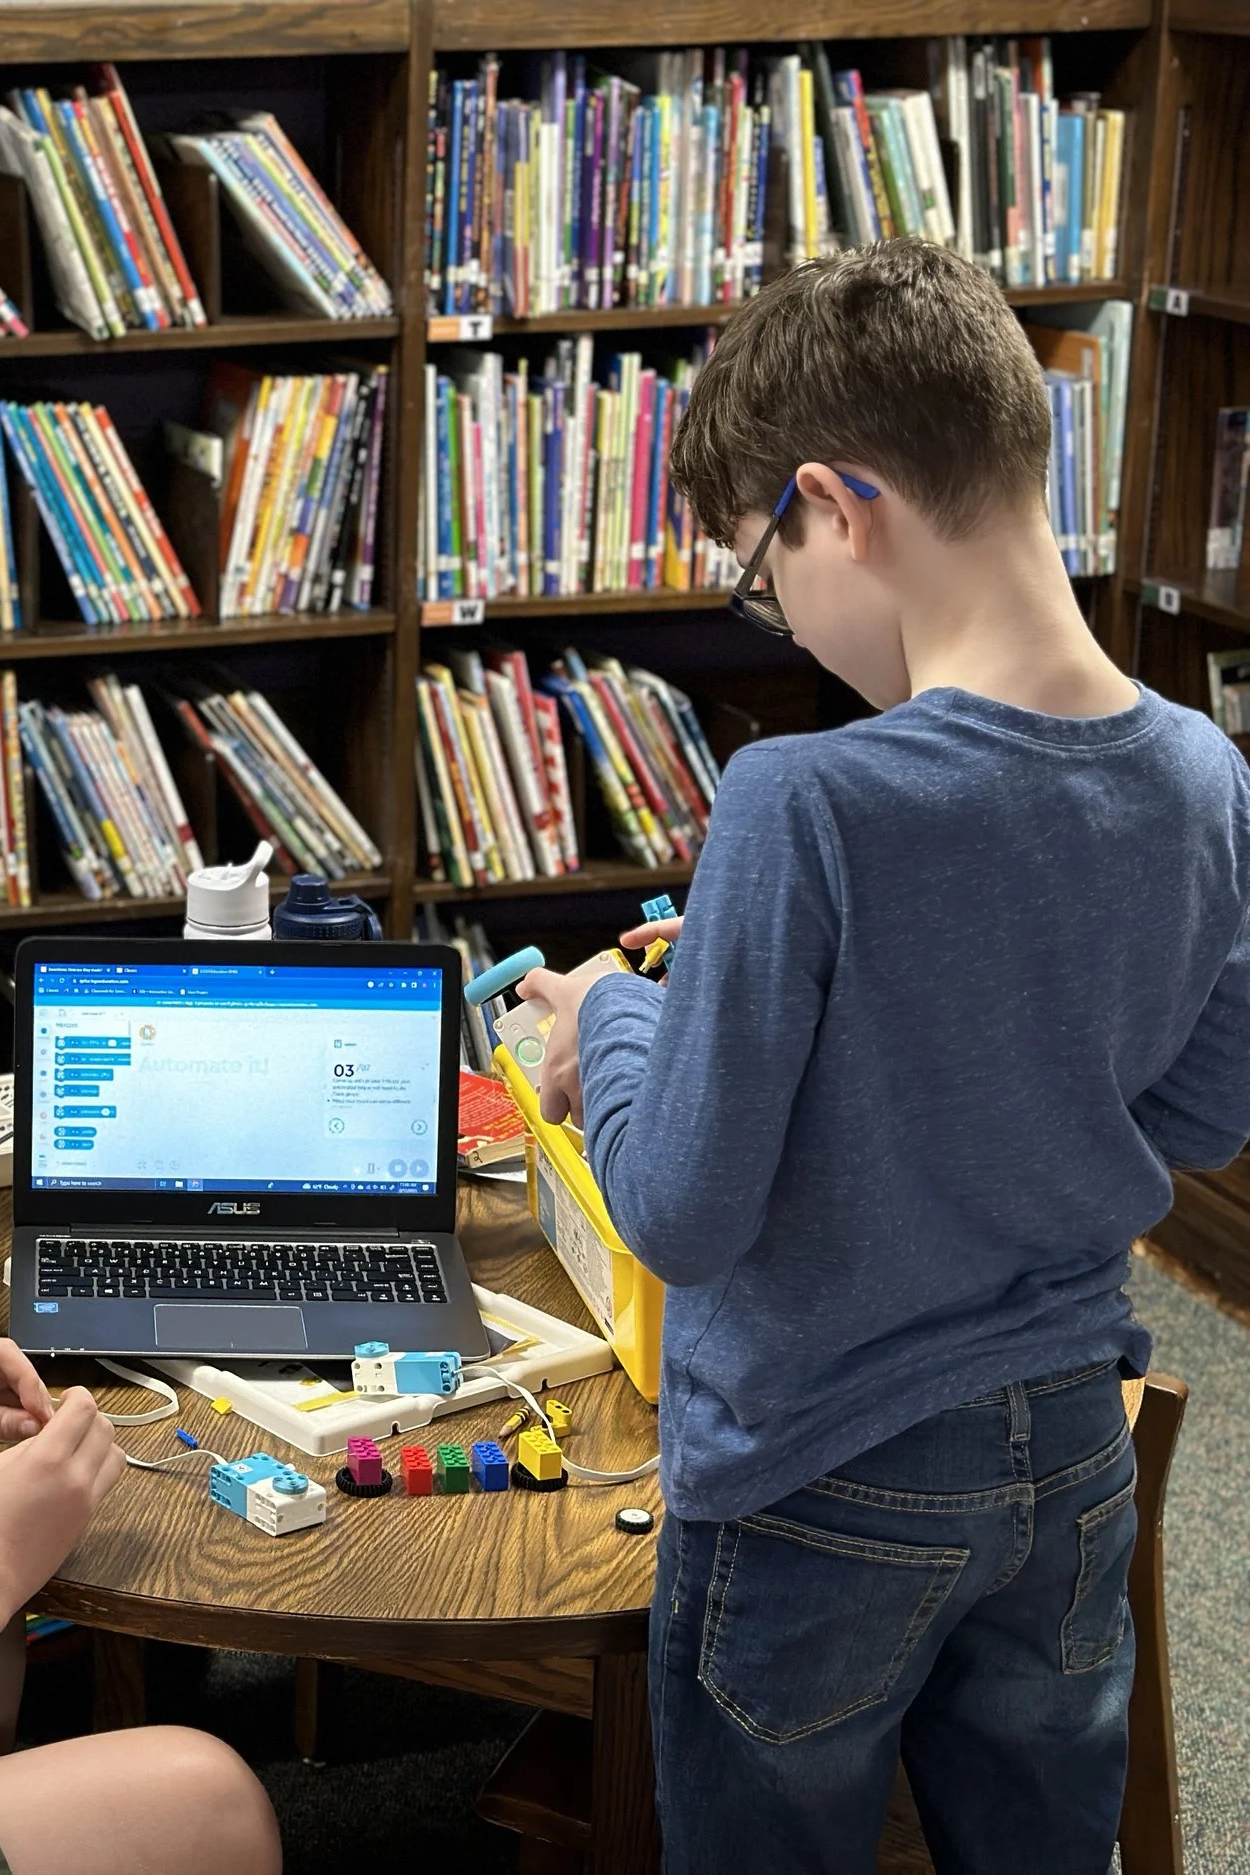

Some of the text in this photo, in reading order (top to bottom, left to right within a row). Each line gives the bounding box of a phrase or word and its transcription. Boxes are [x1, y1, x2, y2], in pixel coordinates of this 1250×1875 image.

[469, 320, 483, 338] T
[460, 604, 478, 619] W
[139, 1055, 243, 1074] Automate
[333, 1064, 355, 1077] 03
[472, 1150, 483, 1164] 2
[206, 1202, 261, 1215] ASUS
